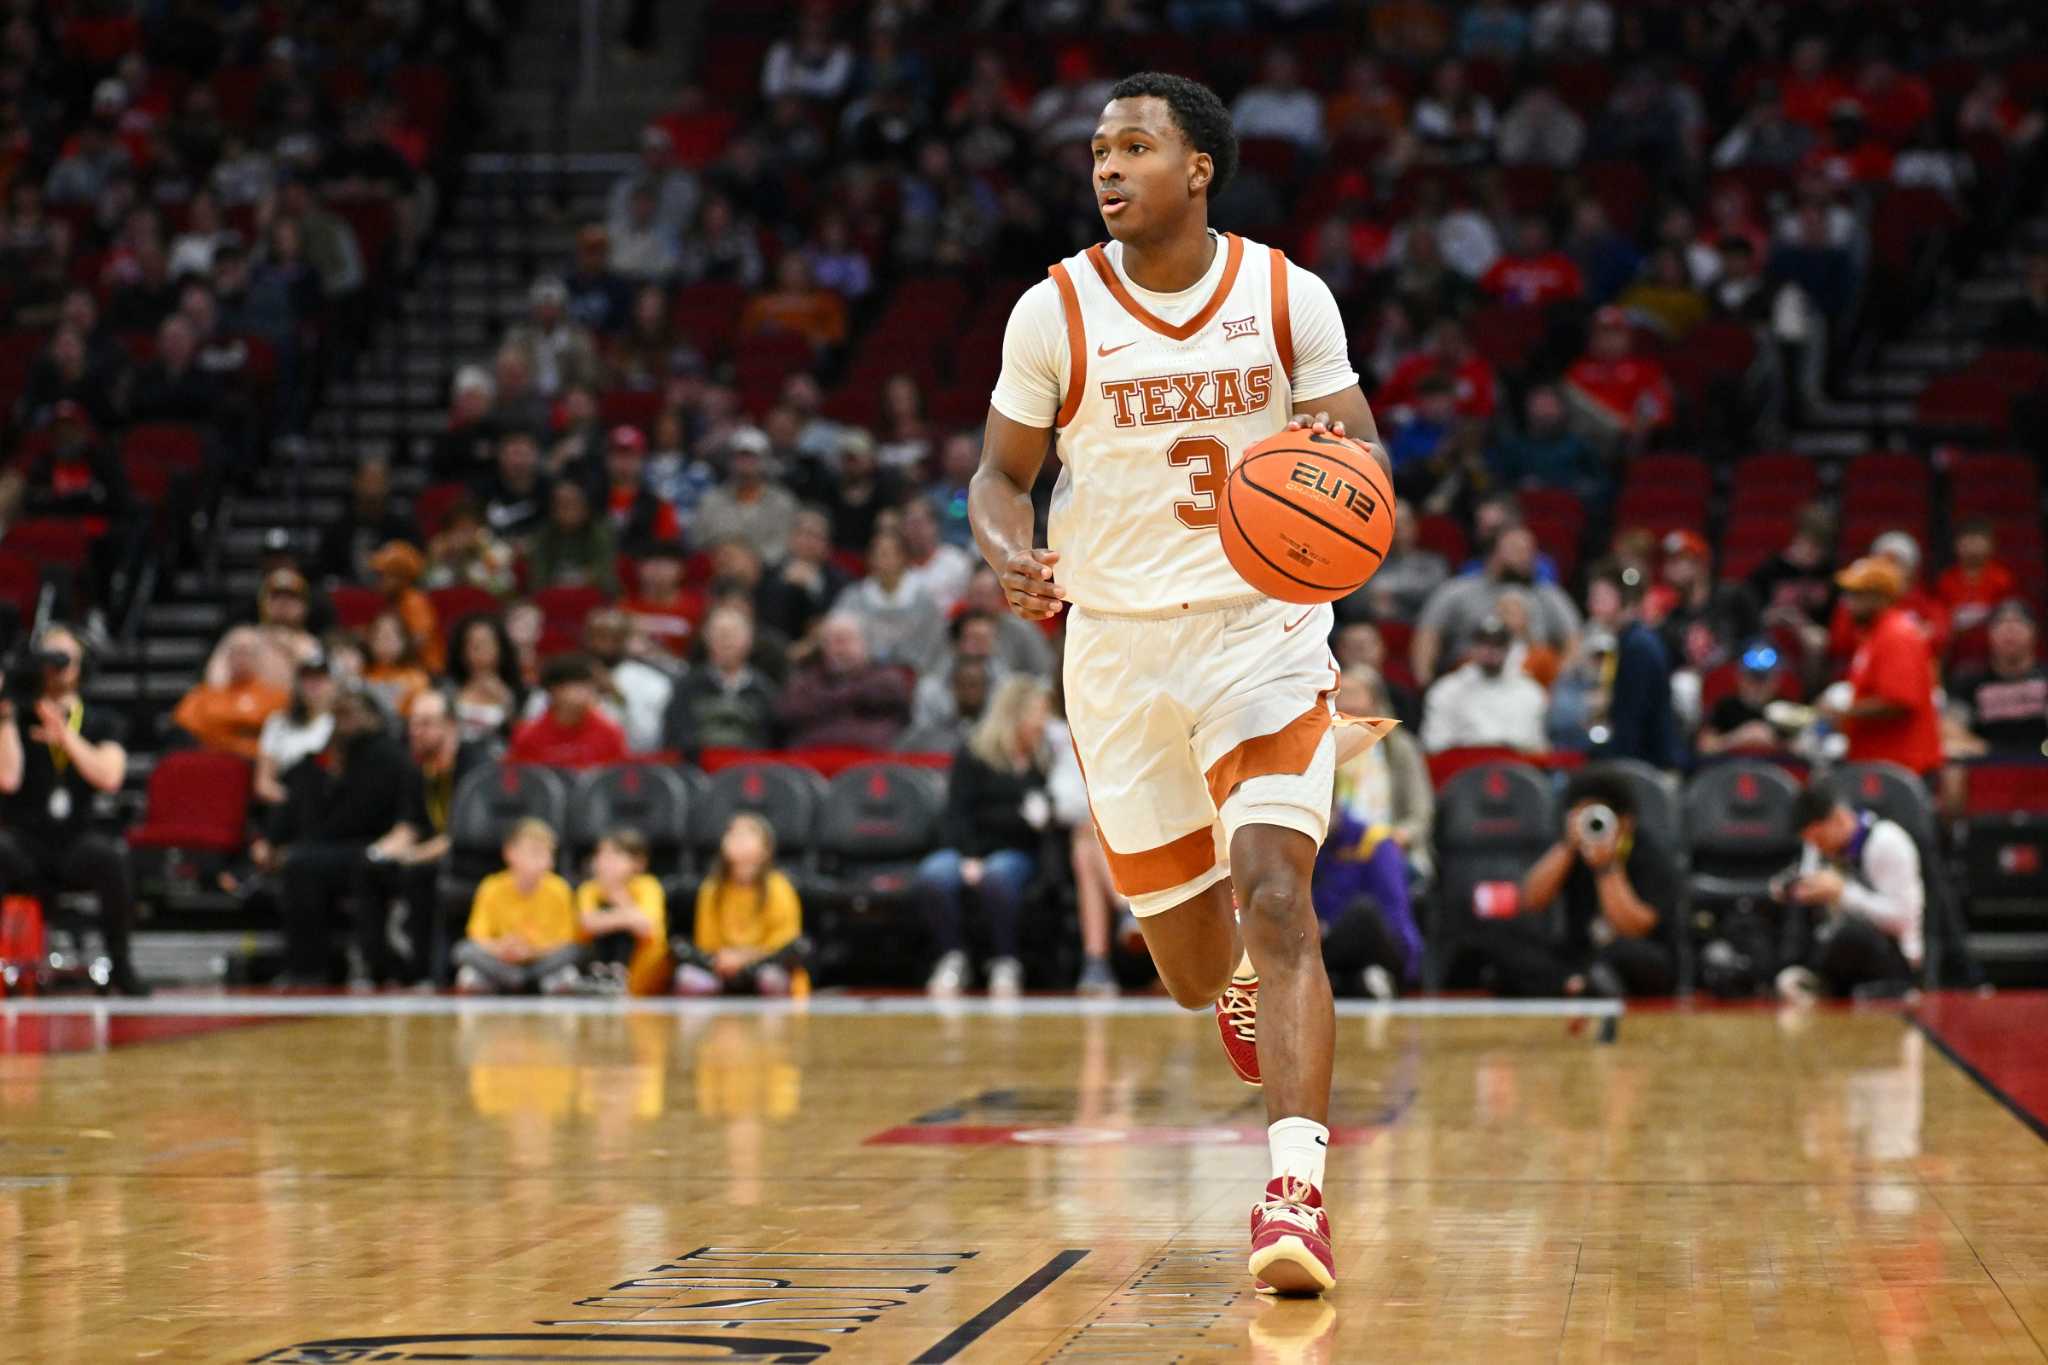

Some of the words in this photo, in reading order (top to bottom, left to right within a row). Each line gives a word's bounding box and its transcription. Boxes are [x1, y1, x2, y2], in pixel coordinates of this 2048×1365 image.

[1101, 364, 1272, 428] TEXAS
[1167, 435, 1231, 529] 3
[1291, 461, 1376, 523] ELITE
